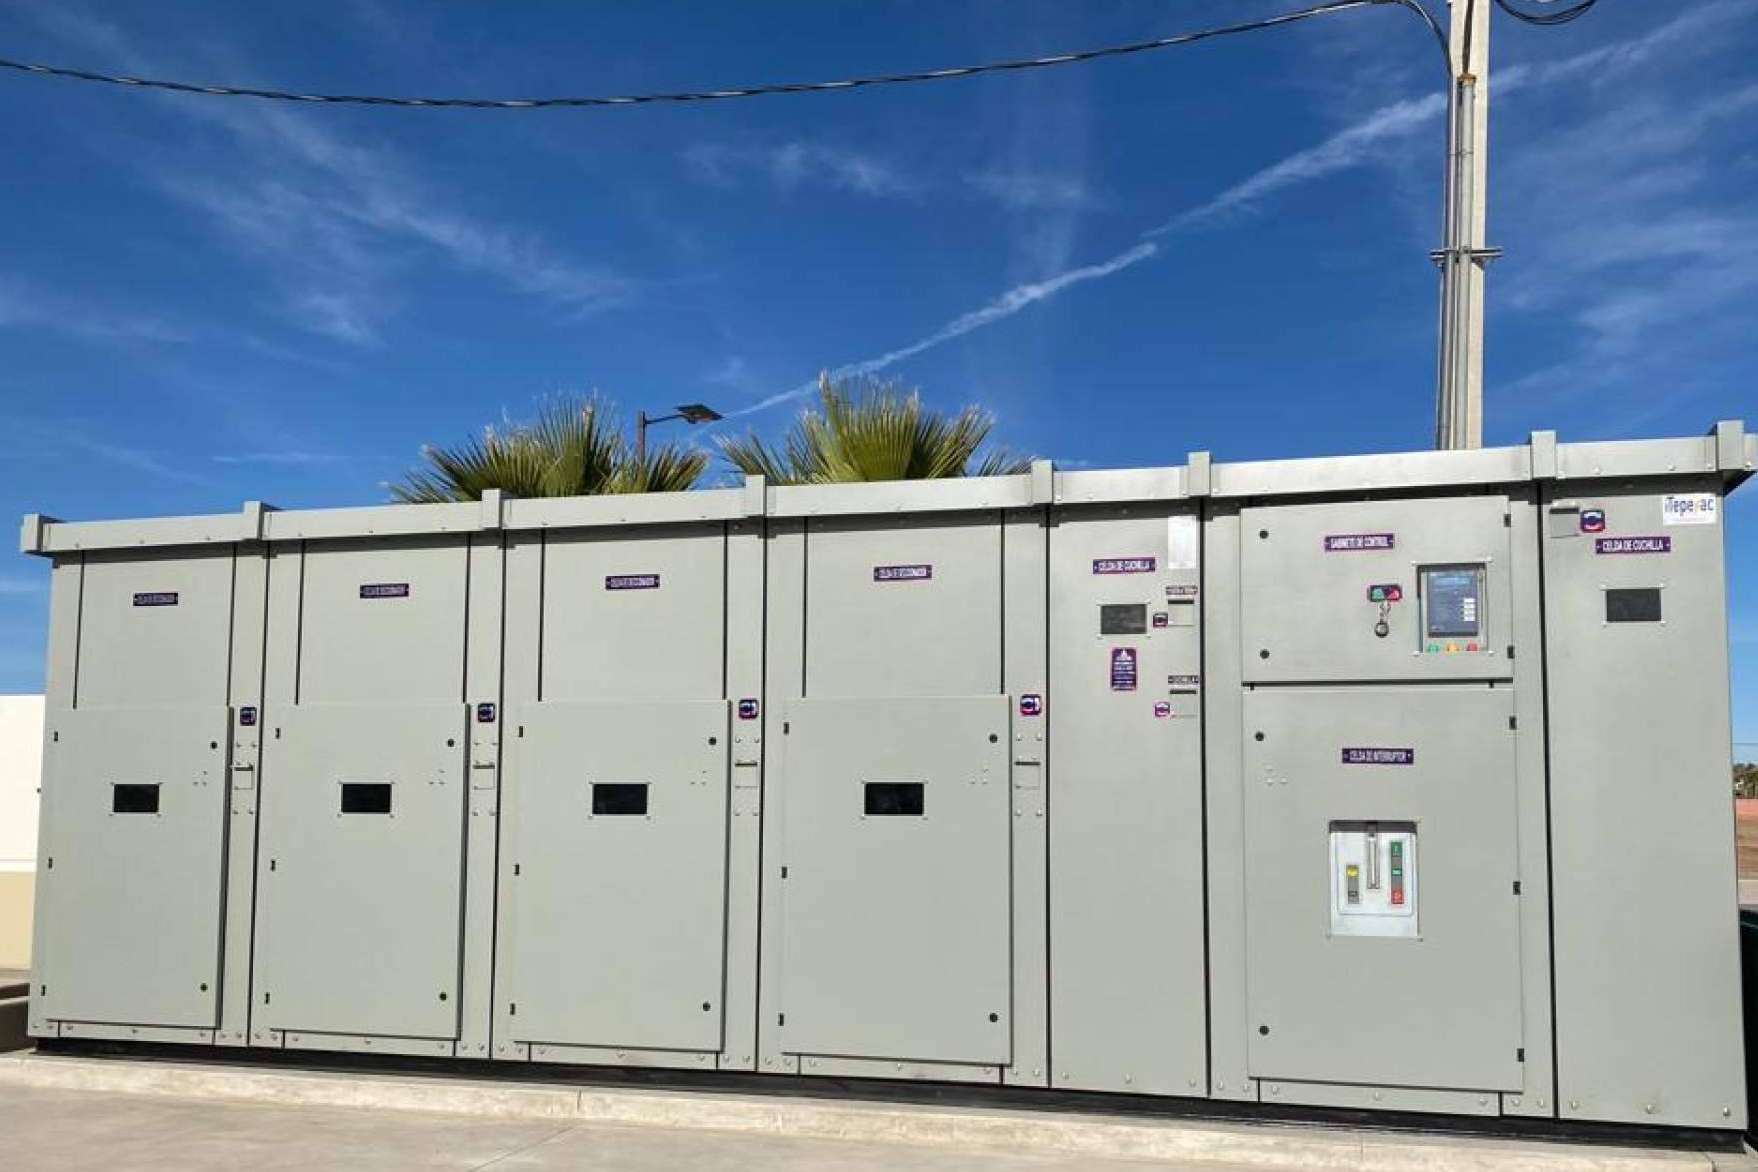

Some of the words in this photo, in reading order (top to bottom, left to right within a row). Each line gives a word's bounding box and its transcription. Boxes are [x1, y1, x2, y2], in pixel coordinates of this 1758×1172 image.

[1602, 539, 1623, 552] CELDA
[1623, 539, 1632, 551] DE
[1632, 538, 1664, 551] CUCHILLA
